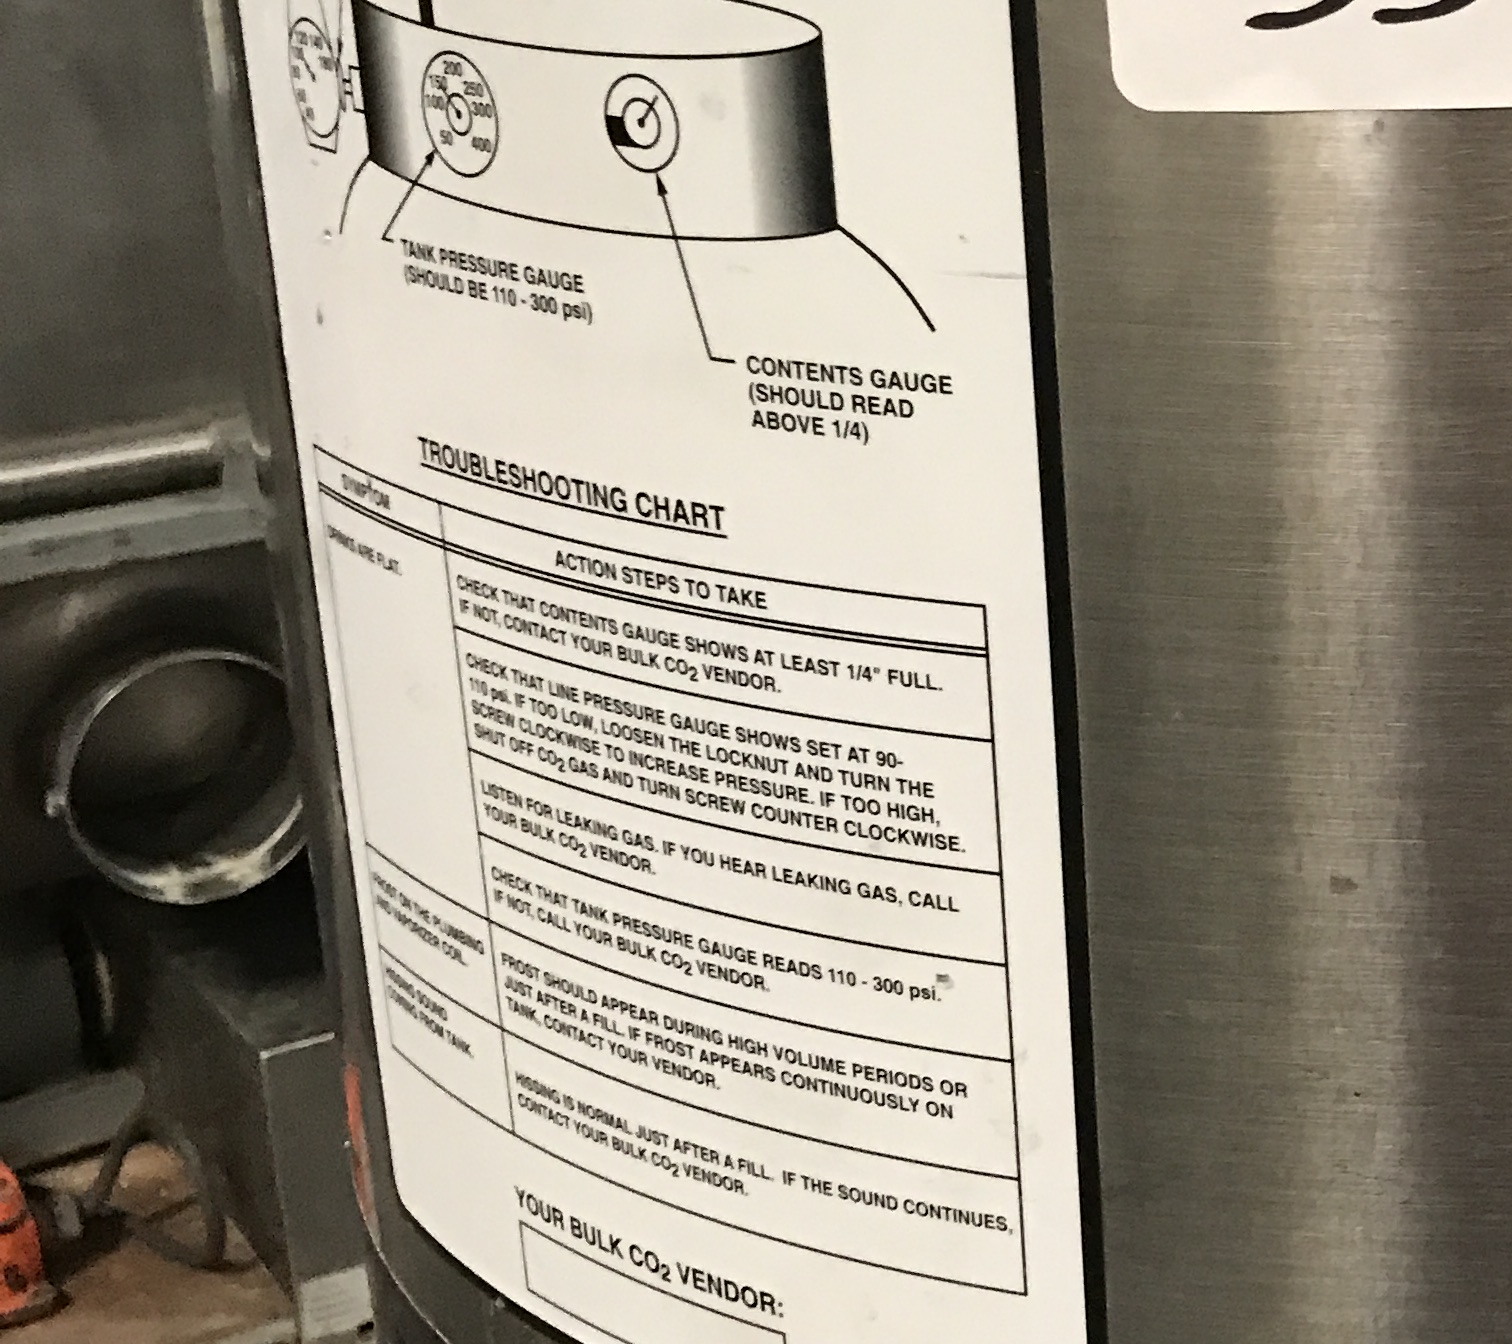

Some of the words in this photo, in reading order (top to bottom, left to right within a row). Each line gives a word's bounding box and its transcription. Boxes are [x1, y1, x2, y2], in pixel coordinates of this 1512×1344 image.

[400, 237, 437, 265] TANK
[438, 247, 521, 283] PRESSURE
[523, 265, 586, 294] GAUGE
[745, 354, 864, 389] CONTENTS
[869, 365, 955, 397] GAUGE
[747, 381, 845, 413] (SHOULD
[851, 391, 915, 420] READ
[750, 409, 826, 438] ABOVE
[830, 419, 871, 446] 1/4)
[417, 436, 628, 514] TROUBLESHOOTING
[634, 492, 726, 532] CHART
[554, 549, 617, 582] ACTION
[621, 564, 680, 595] STEPS
[684, 576, 711, 601] TO
[715, 582, 769, 611] TAKE
[456, 573, 498, 604] CHECK
[501, 586, 535, 614] THAT
[539, 600, 619, 636] CONTENTS
[622, 622, 681, 650] GAUGE
[684, 635, 749, 663] SHOWS
[753, 649, 775, 667] AT
[780, 654, 841, 678] LEAST
[887, 668, 943, 692] FULL.
[513, 1184, 566, 1232] YOUR
[568, 1215, 625, 1260] BULK
[675, 1261, 785, 1319] VENDOR:
